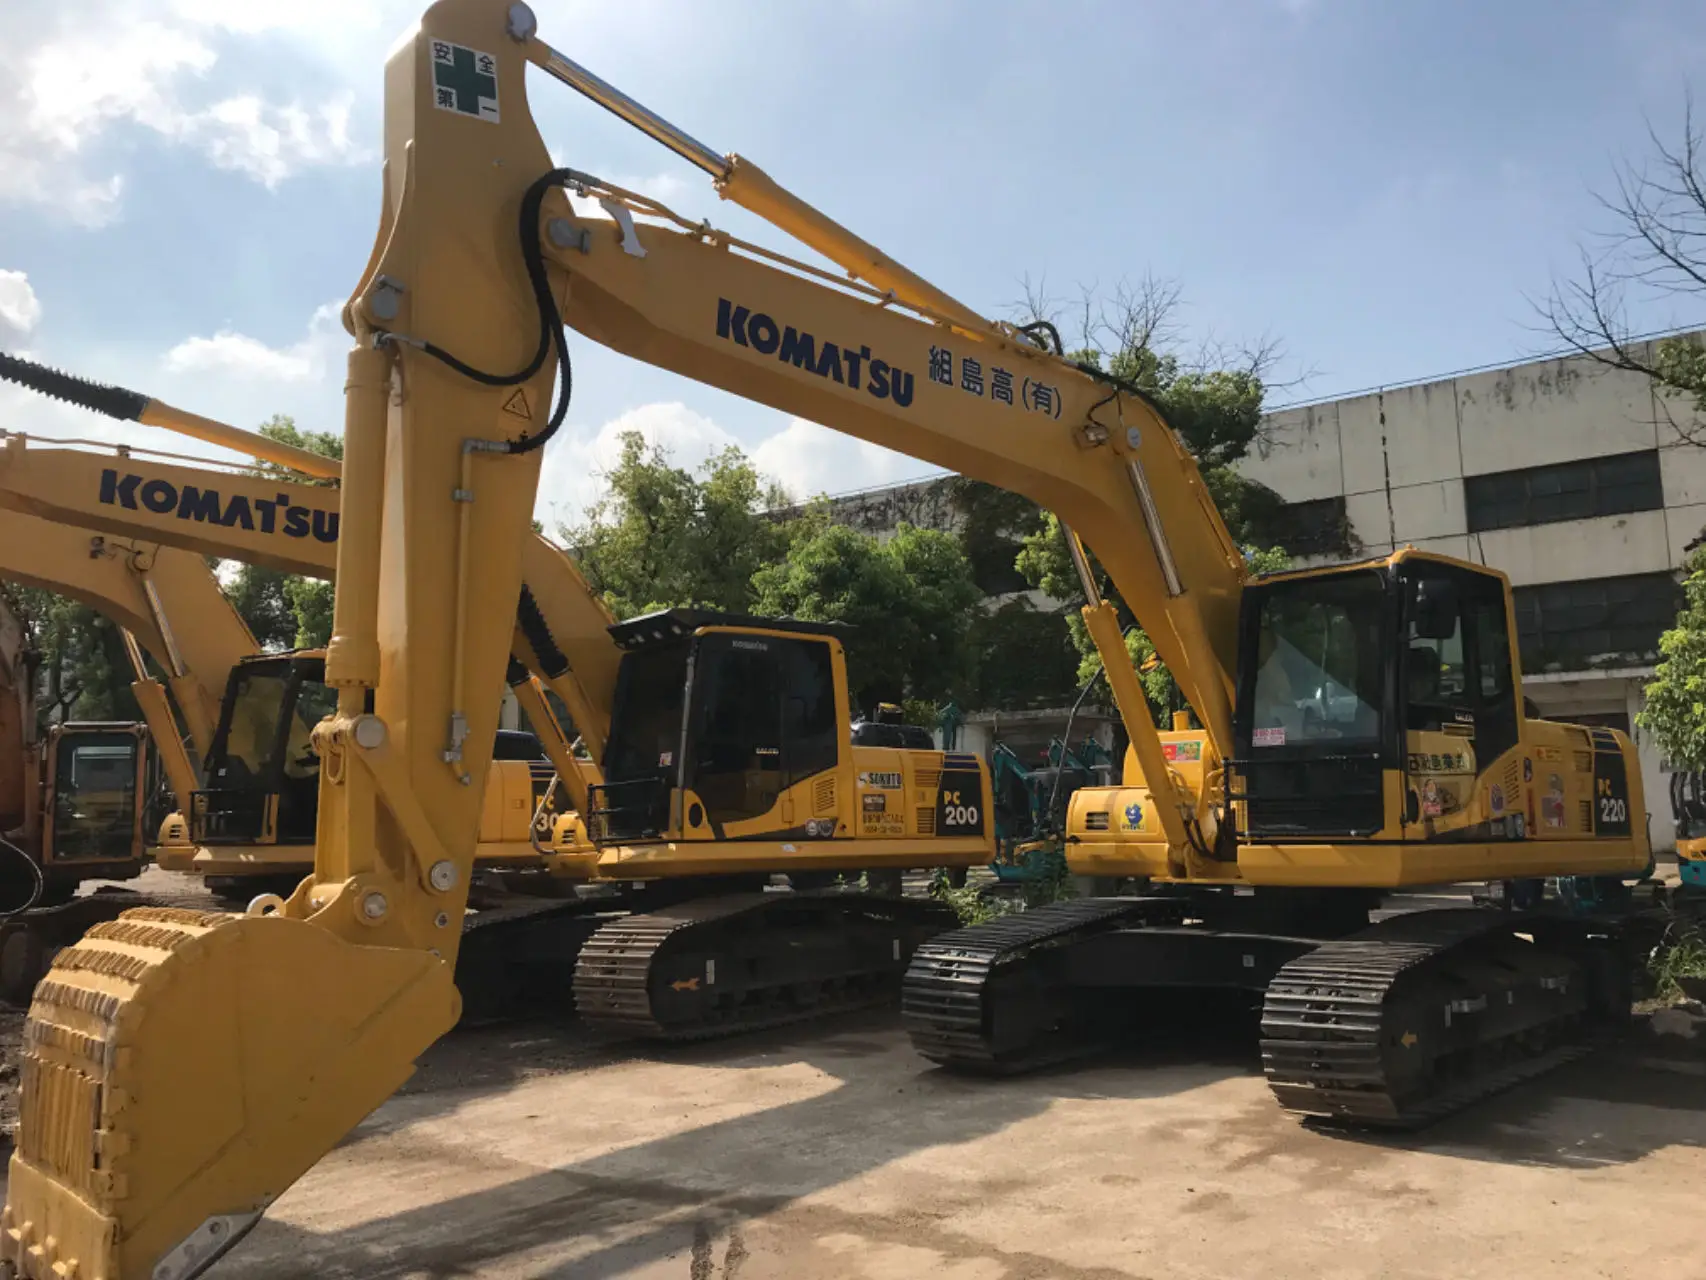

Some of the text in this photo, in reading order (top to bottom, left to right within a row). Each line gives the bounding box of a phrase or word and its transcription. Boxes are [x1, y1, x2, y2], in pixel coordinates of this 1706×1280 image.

[715, 297, 914, 408] KOMATSU
[99, 469, 340, 543] KOMATSU
[943, 790, 961, 805] PC
[945, 806, 978, 826] 200
[1600, 798, 1626, 822] 220
